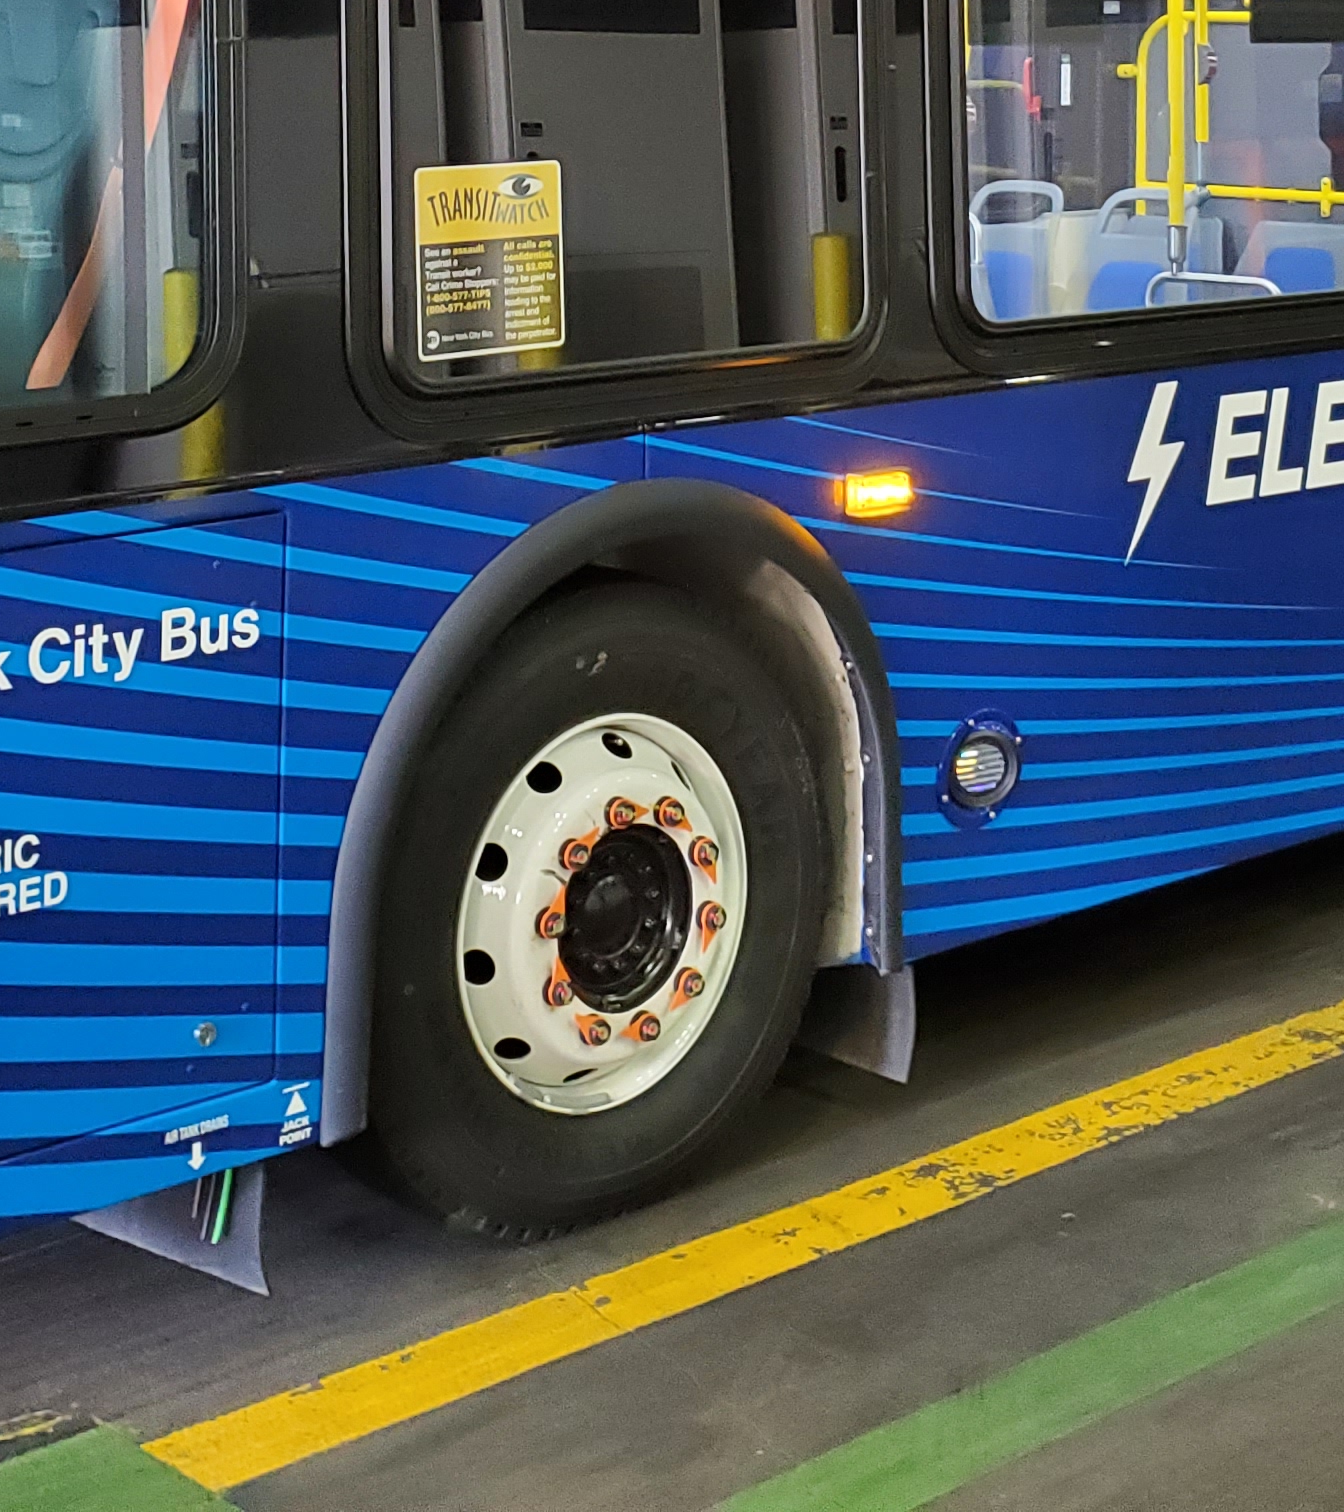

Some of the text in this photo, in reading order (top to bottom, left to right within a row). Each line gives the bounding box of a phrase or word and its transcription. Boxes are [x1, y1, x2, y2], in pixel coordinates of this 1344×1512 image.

[27, 623, 145, 684] City
[160, 606, 261, 662] Bus
[280, 1114, 310, 1133] JACK
[278, 1126, 313, 1147] POINT
